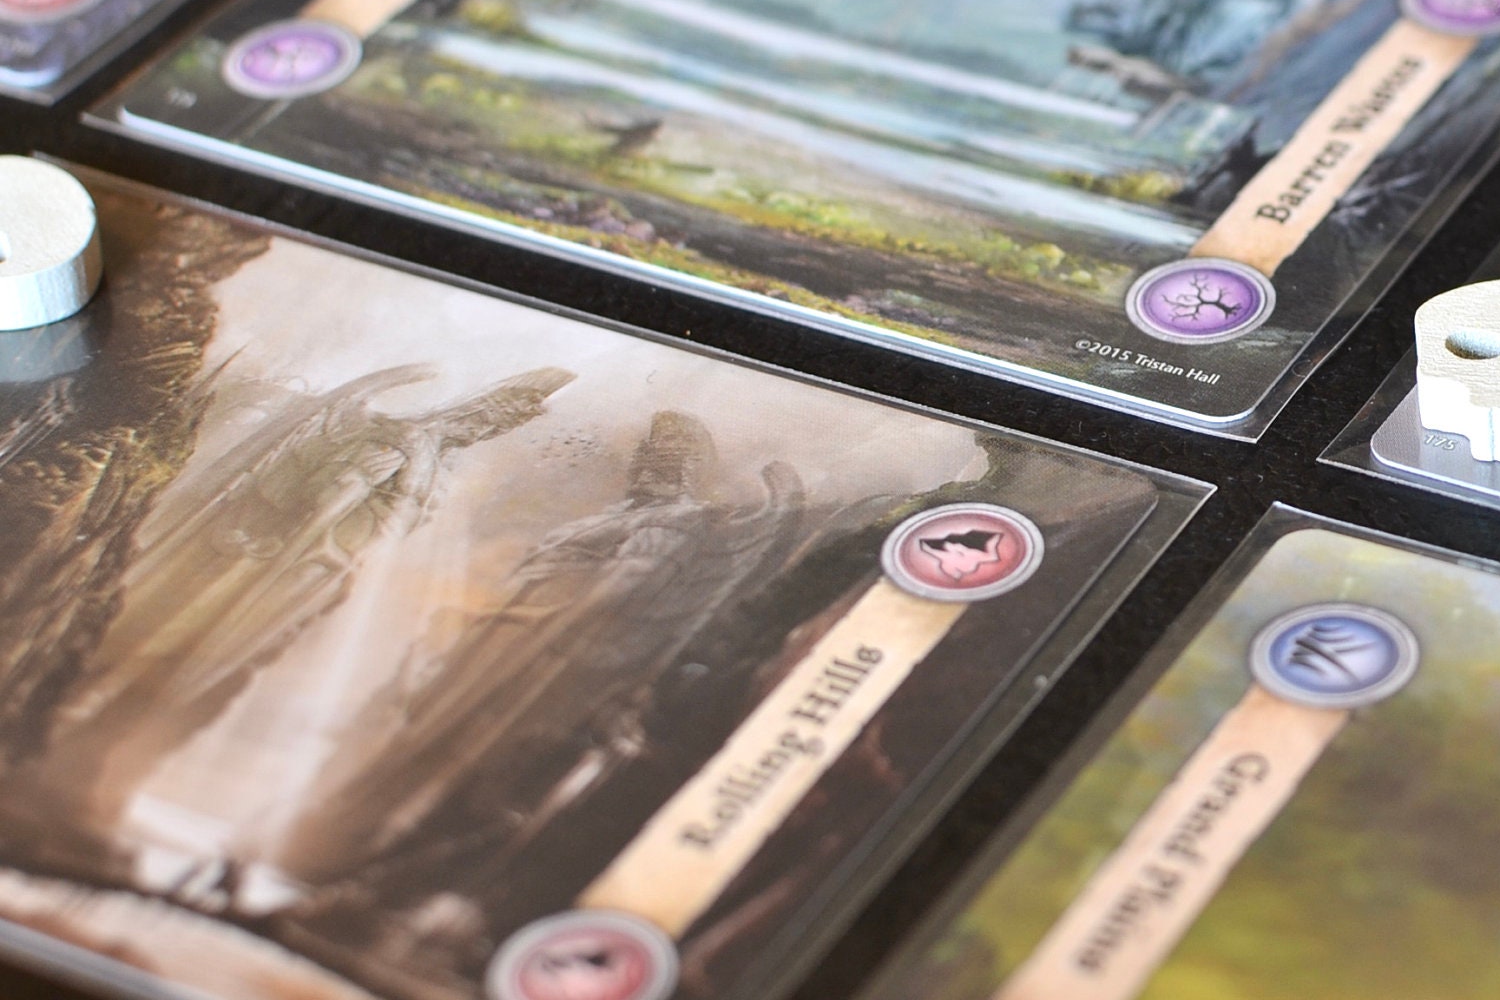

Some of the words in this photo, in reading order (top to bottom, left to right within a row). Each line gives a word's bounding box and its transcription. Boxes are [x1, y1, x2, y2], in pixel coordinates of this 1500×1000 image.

[1255, 140, 1351, 224] Barren
[1075, 339, 1132, 361] ©2015
[1134, 353, 1184, 376] Tristan
[1186, 368, 1221, 385] Hall
[1424, 434, 1456, 451] 175
[677, 728, 826, 850] Rolling
[793, 642, 884, 740] Hills
[1171, 751, 1271, 862] Grand
